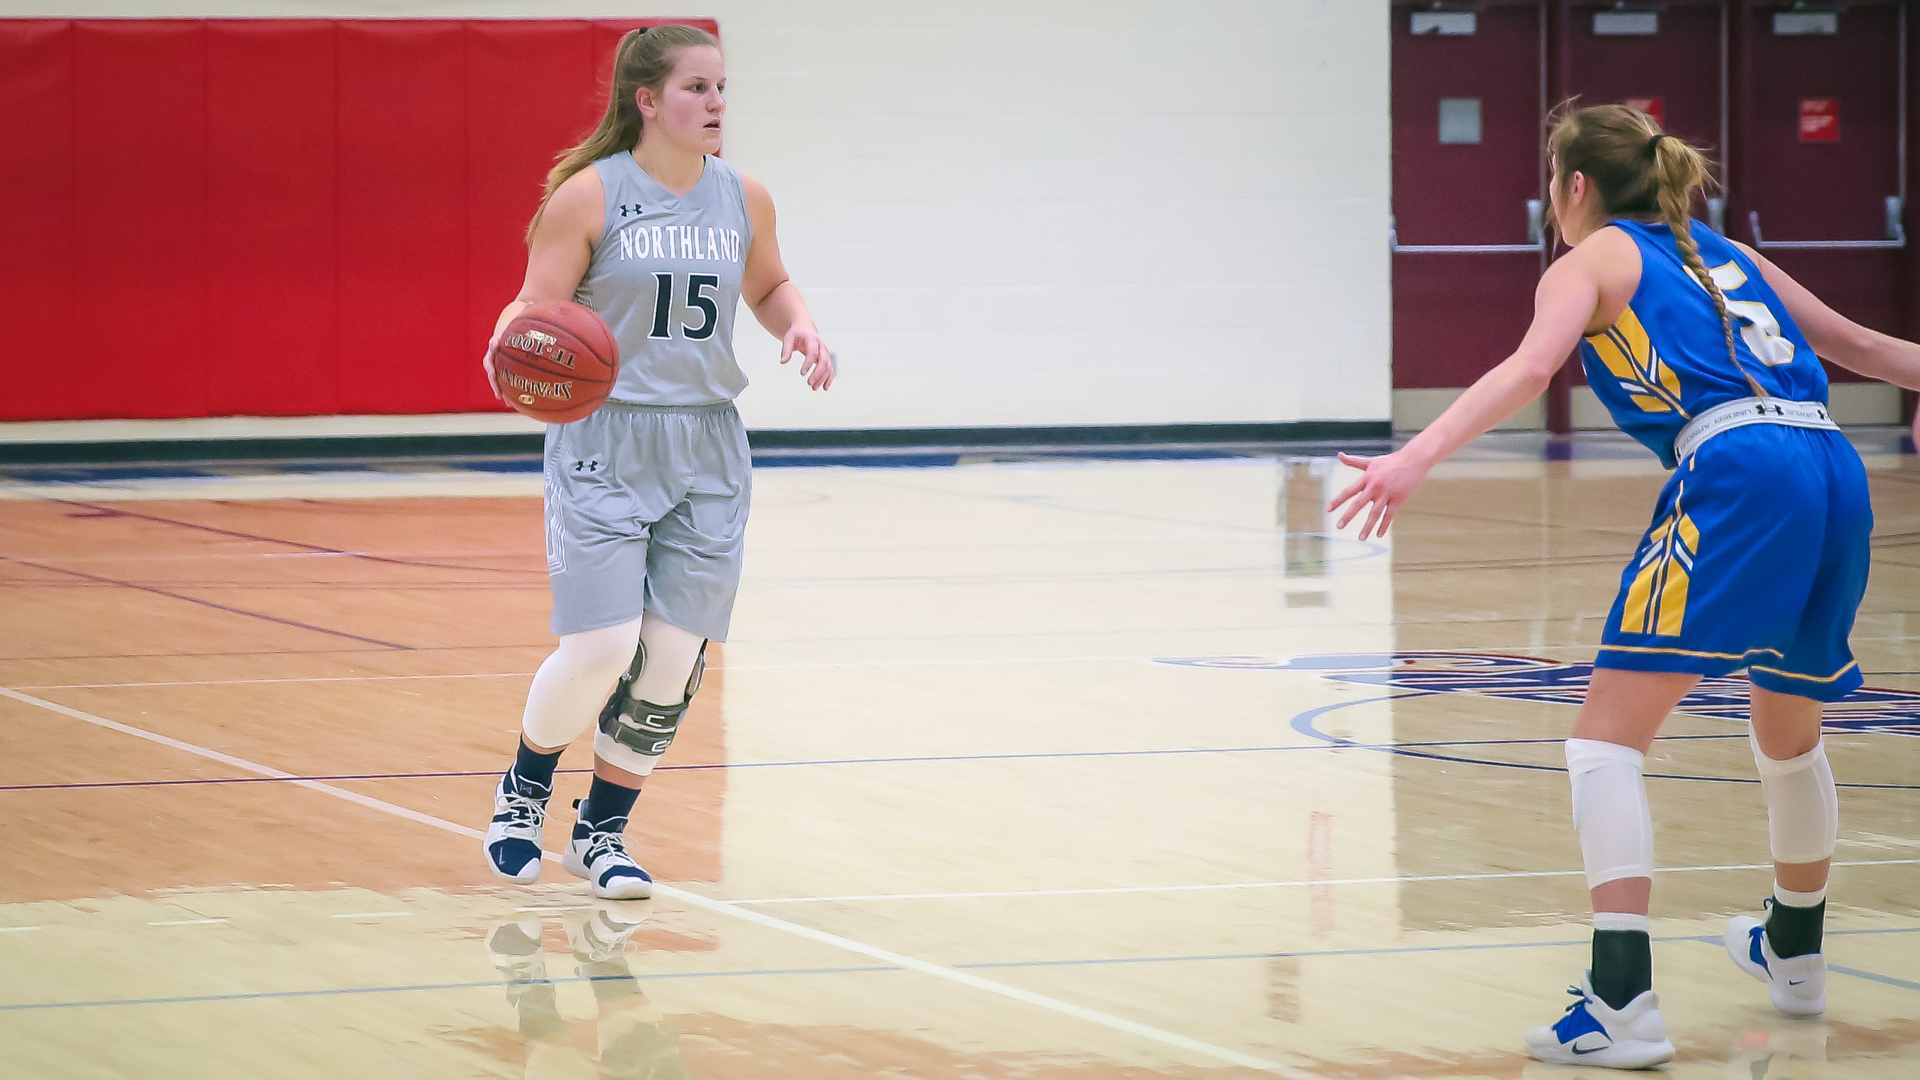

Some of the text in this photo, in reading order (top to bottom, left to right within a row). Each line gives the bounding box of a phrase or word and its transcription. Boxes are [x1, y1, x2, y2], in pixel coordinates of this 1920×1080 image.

[620, 225, 740, 263] NORTHLAND
[646, 271, 721, 342] 15
[499, 366, 574, 401] SPALDIN
